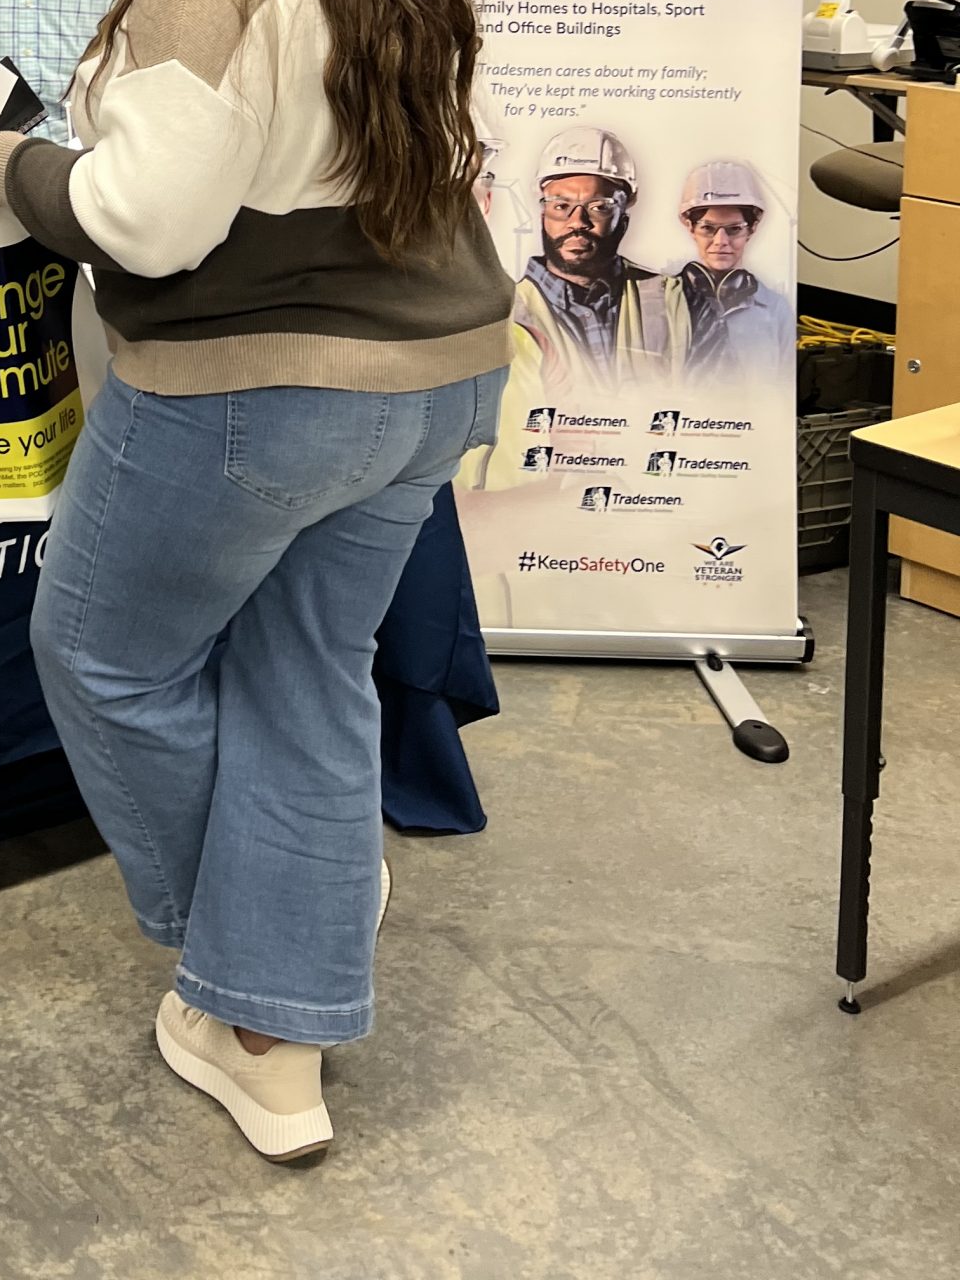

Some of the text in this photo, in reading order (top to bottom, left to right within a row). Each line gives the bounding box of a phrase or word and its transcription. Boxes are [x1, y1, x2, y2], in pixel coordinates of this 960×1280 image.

[475, 1, 704, 18] amily Homes to Hospitals, Sport
[477, 21, 621, 37] and Office Buildings
[556, 66, 591, 77] cares
[594, 65, 633, 77] about
[638, 68, 659, 81] my
[661, 65, 708, 81] family;
[491, 83, 742, 102] They’ve kept me working consistently
[504, 103, 525, 117] for
[528, 103, 537, 116] 9
[556, 414, 627, 428] Tradesmen
[681, 417, 752, 431] Tradesmen
[18, 422, 57, 456] your
[59, 408, 76, 434] life
[553, 453, 625, 467] Tradesmen
[677, 457, 749, 471] Tradesmen
[612, 493, 682, 506] Tradesmen
[518, 551, 665, 574] #KeepSafetyOne
[693, 566, 742, 575] VETERAN
